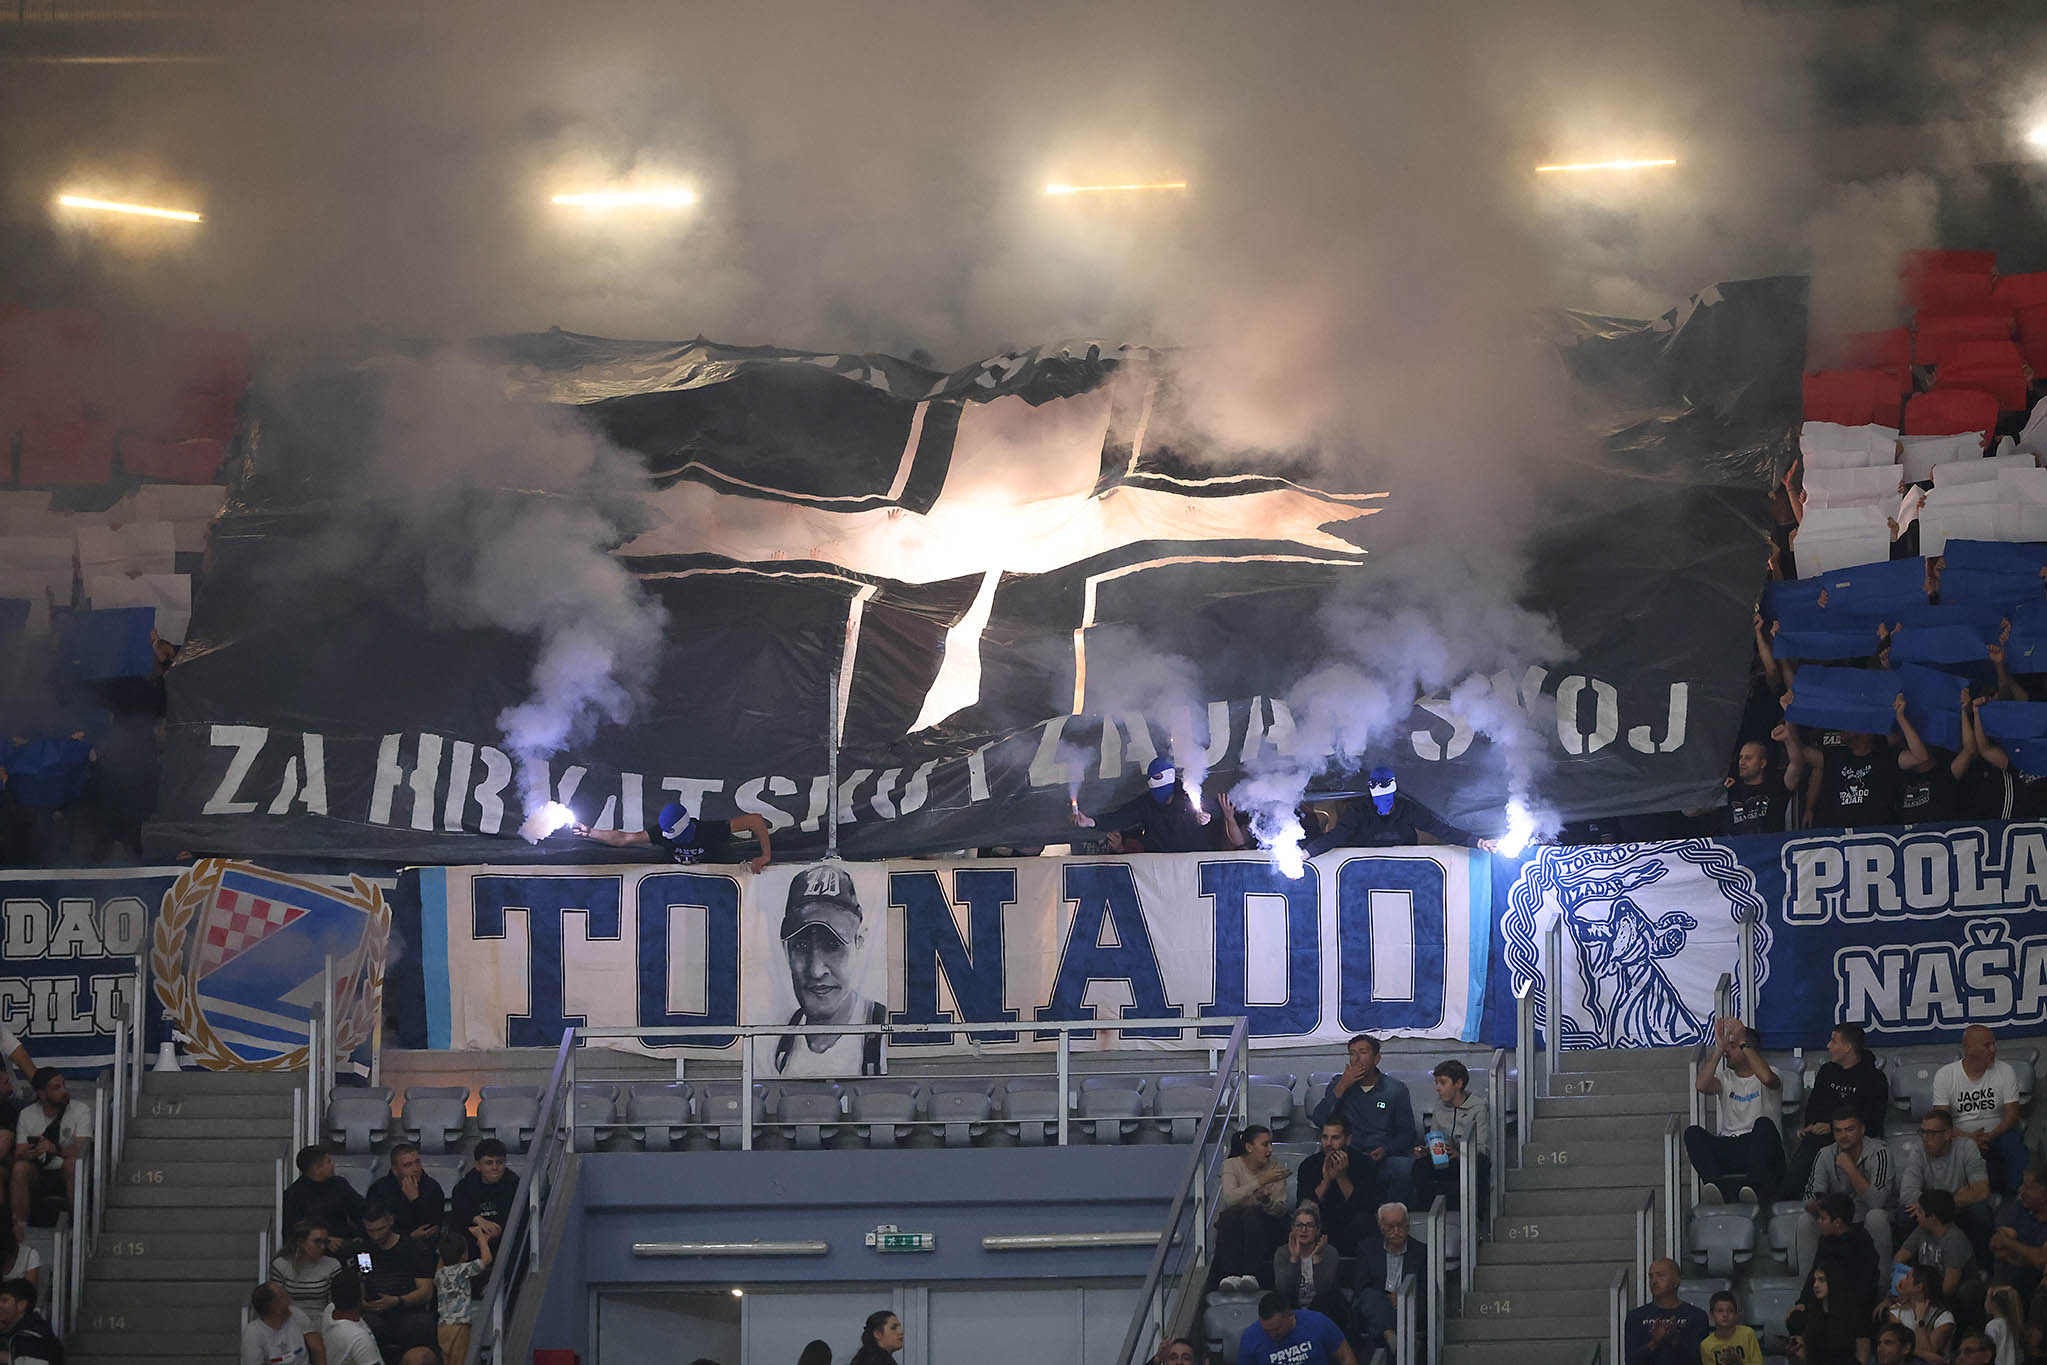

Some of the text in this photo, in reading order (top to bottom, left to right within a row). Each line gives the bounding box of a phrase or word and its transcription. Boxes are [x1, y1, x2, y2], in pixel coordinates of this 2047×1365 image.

[202, 725, 328, 815] ZA
[1563, 843, 1640, 876] TORNADO
[1793, 833, 2047, 914] PROLA
[1572, 879, 1624, 902] ZADAR
[5, 898, 147, 959] DAO
[1957, 1100, 1995, 1113] JONES
[1269, 1341, 1312, 1363] PRVACI
